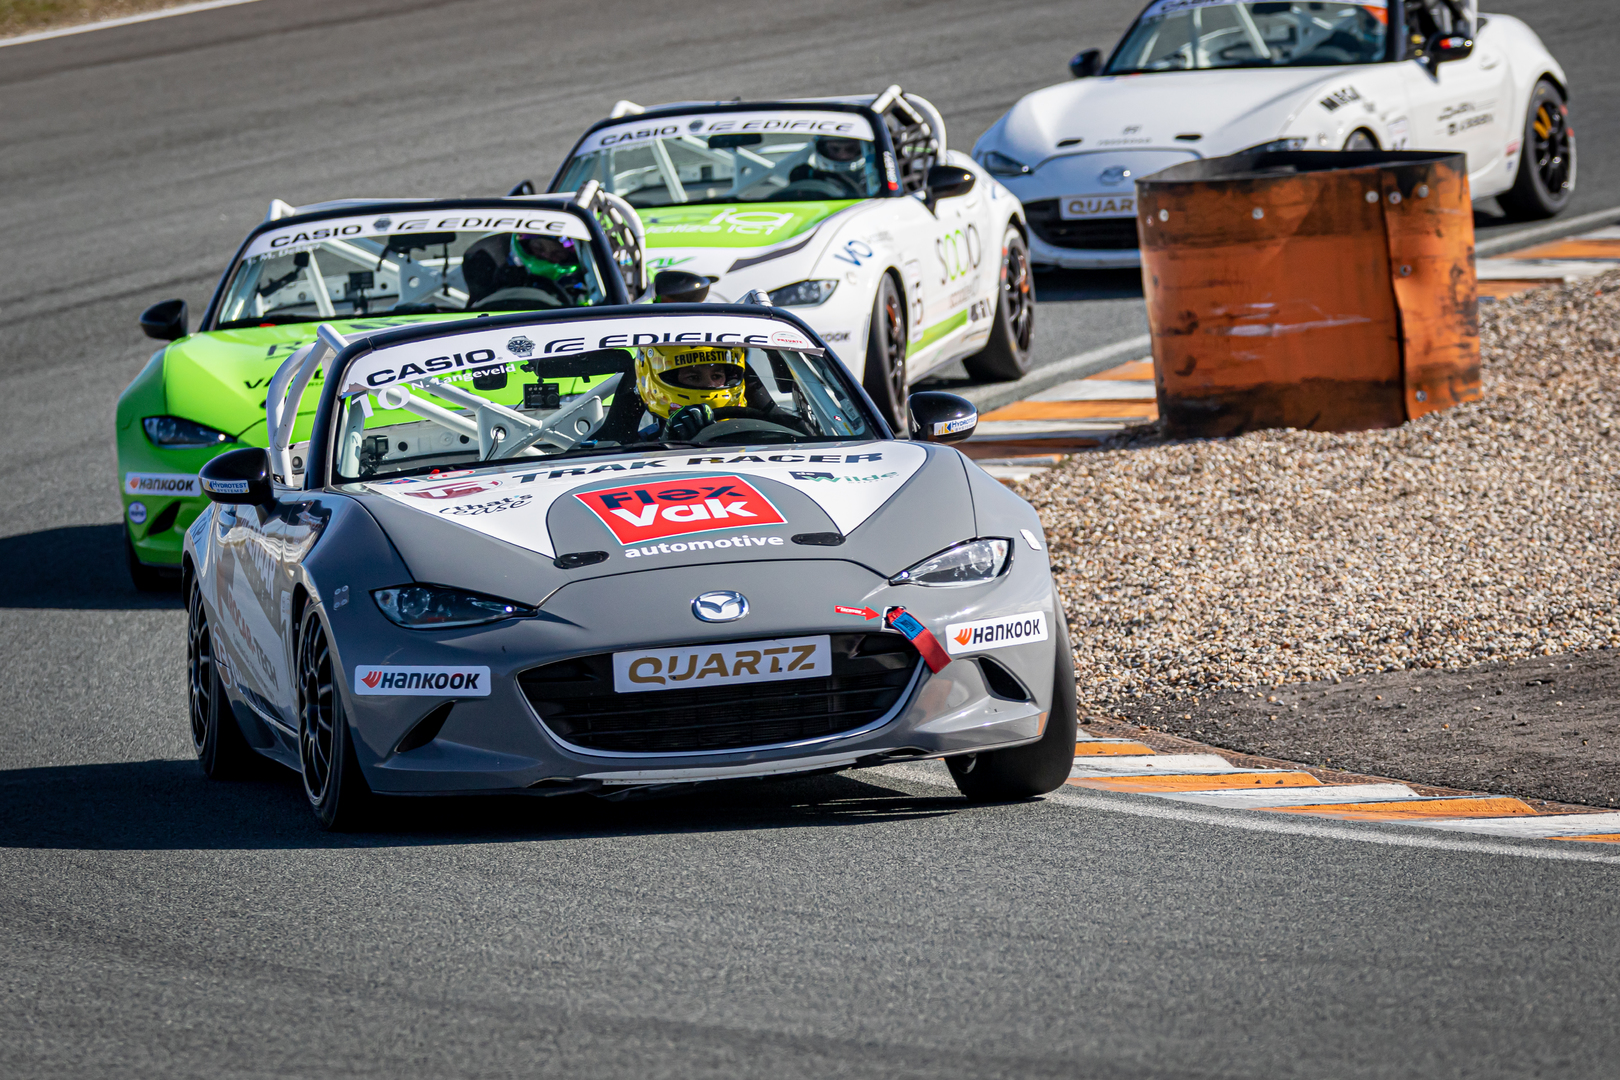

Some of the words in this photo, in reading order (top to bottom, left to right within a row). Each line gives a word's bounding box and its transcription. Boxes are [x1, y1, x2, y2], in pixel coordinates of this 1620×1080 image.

[601, 125, 678, 146] CASIO
[742, 119, 855, 132] EDIFICE
[1068, 199, 1135, 215] QUAR
[270, 224, 362, 248] CASIO
[437, 217, 567, 233] EDIFICE
[366, 348, 496, 387] CASIO
[599, 332, 768, 349] EDIFICE
[411, 381, 430, 391] N.
[435, 364, 516, 385] Langeveld
[351, 385, 410, 418] 10
[513, 459, 667, 484] TRAK
[687, 452, 884, 466] RACER
[599, 484, 746, 510] Flex
[609, 498, 759, 527] Vak
[625, 535, 784, 559] automotive
[628, 643, 816, 685] QUARTZ
